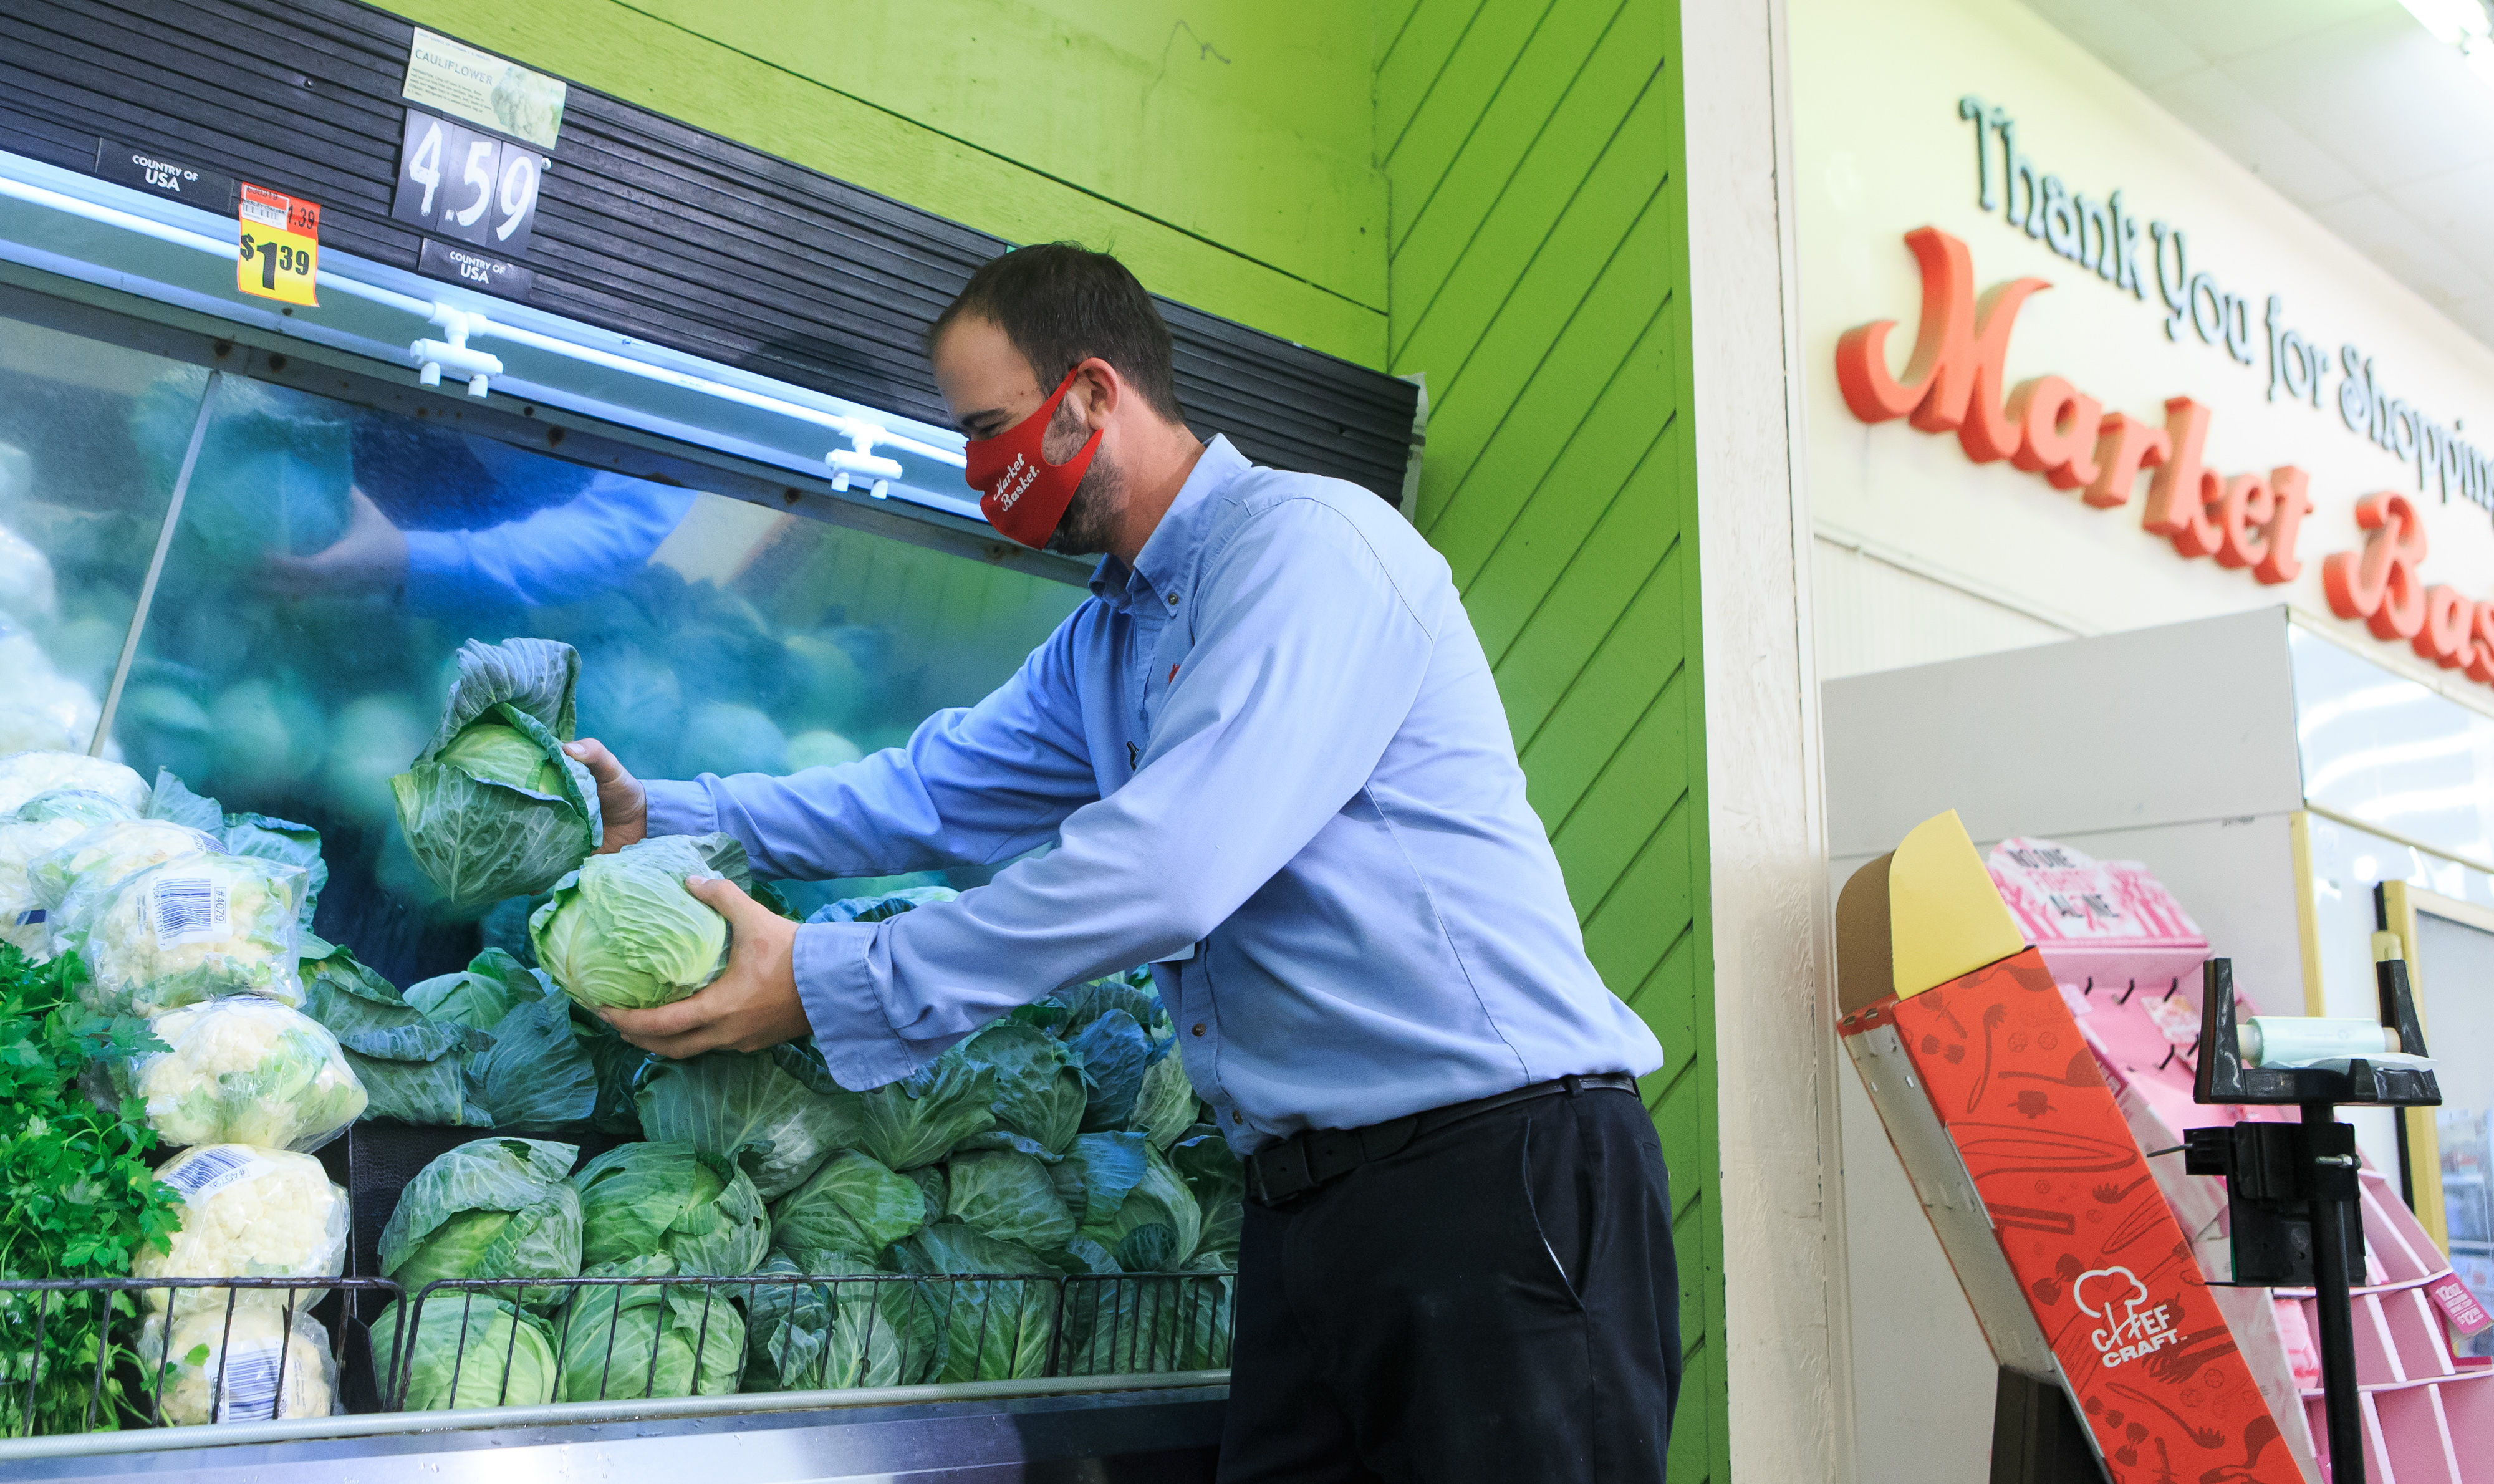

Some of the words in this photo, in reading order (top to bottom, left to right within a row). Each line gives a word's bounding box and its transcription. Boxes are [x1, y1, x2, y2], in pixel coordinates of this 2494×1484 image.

[415, 49, 493, 85] CAULIFLOWER
[132, 155, 182, 177] COUNTRY
[183, 170, 199, 182] OF
[145, 168, 180, 192] USA
[409, 121, 534, 241] 4.59
[288, 203, 315, 229] 1.39
[450, 251, 491, 270] COUNTRY
[493, 264, 506, 274] OF
[460, 264, 489, 284] USA
[1958, 95, 2147, 301] Thank
[2149, 220, 2254, 366] You
[2265, 294, 2329, 408] for
[2338, 341, 2494, 535] Shoppin
[1836, 225, 2313, 585] Market
[993, 452, 1025, 501] Market
[215, 890, 225, 922] #4079
[2091, 1301, 2170, 1352] CHEF
[2102, 1328, 2177, 1367] CRAFT
